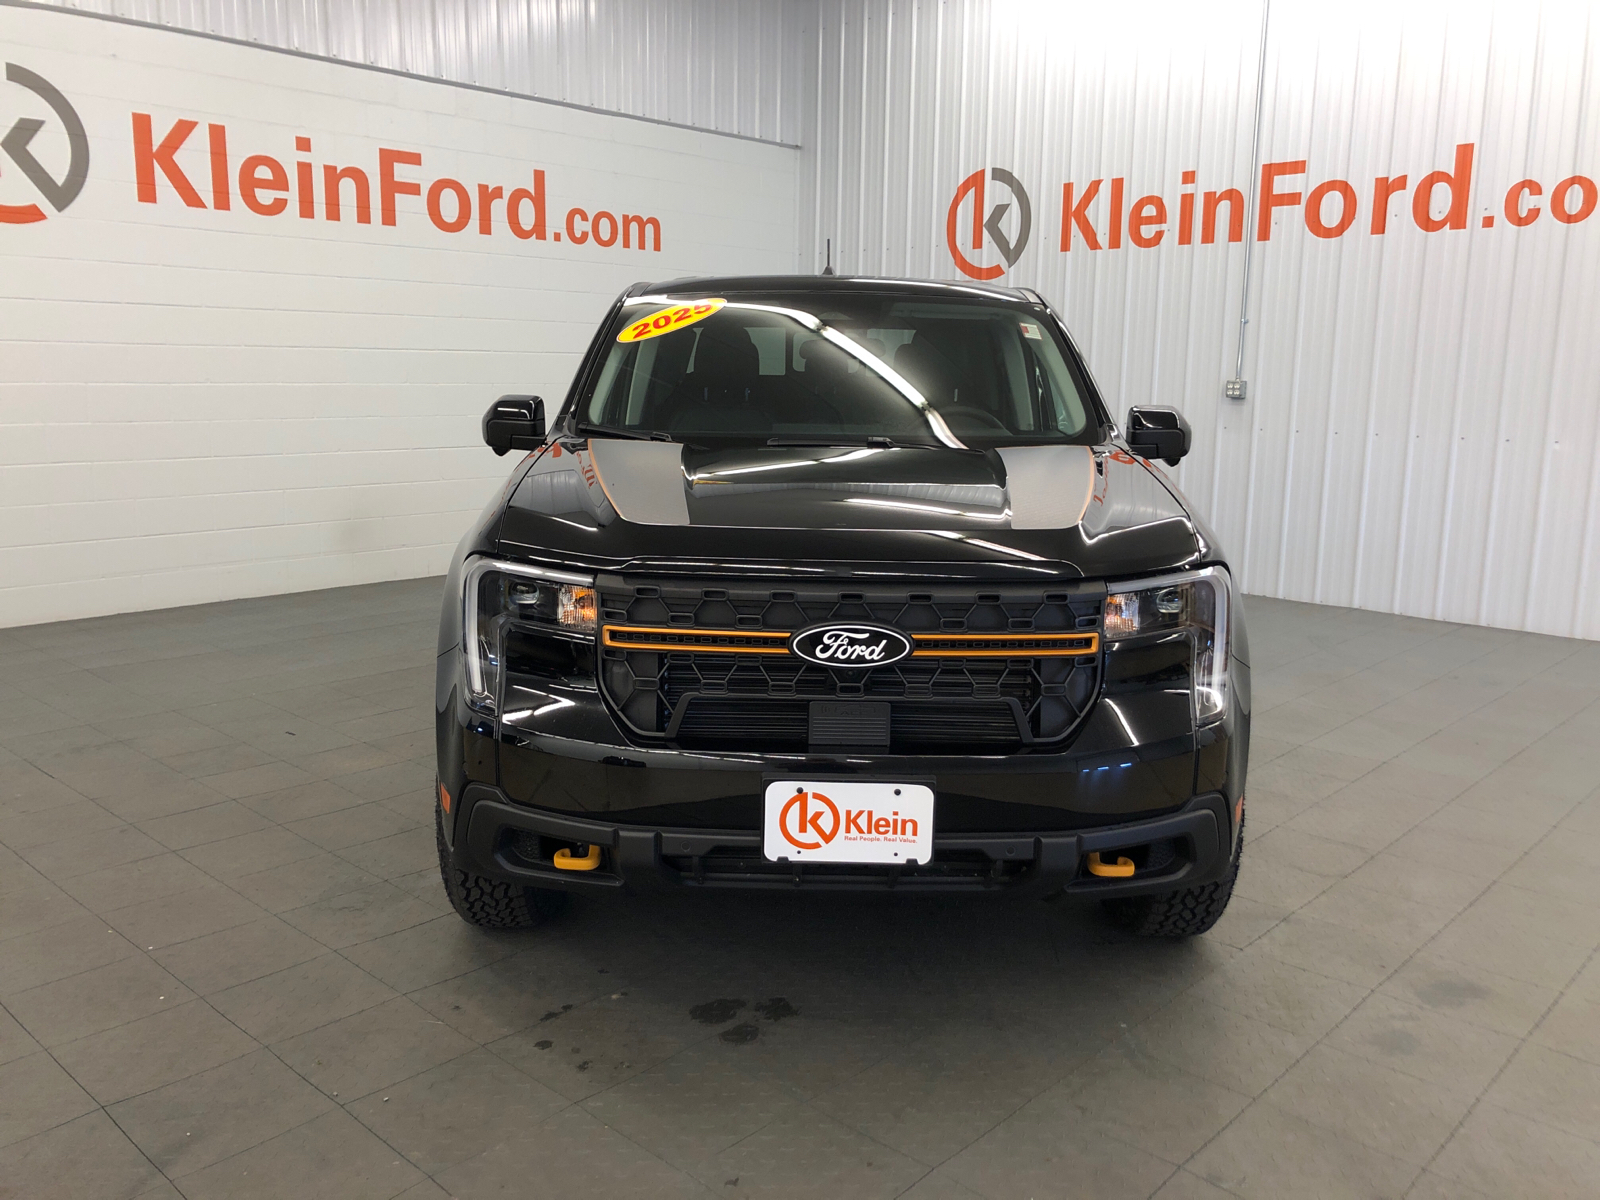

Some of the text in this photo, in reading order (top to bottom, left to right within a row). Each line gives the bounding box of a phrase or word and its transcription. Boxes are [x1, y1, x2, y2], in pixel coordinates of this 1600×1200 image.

[131, 112, 662, 252] KleinFord.com
[632, 304, 712, 339] 2025
[815, 631, 887, 660] Ford
[845, 810, 918, 836] Klein
